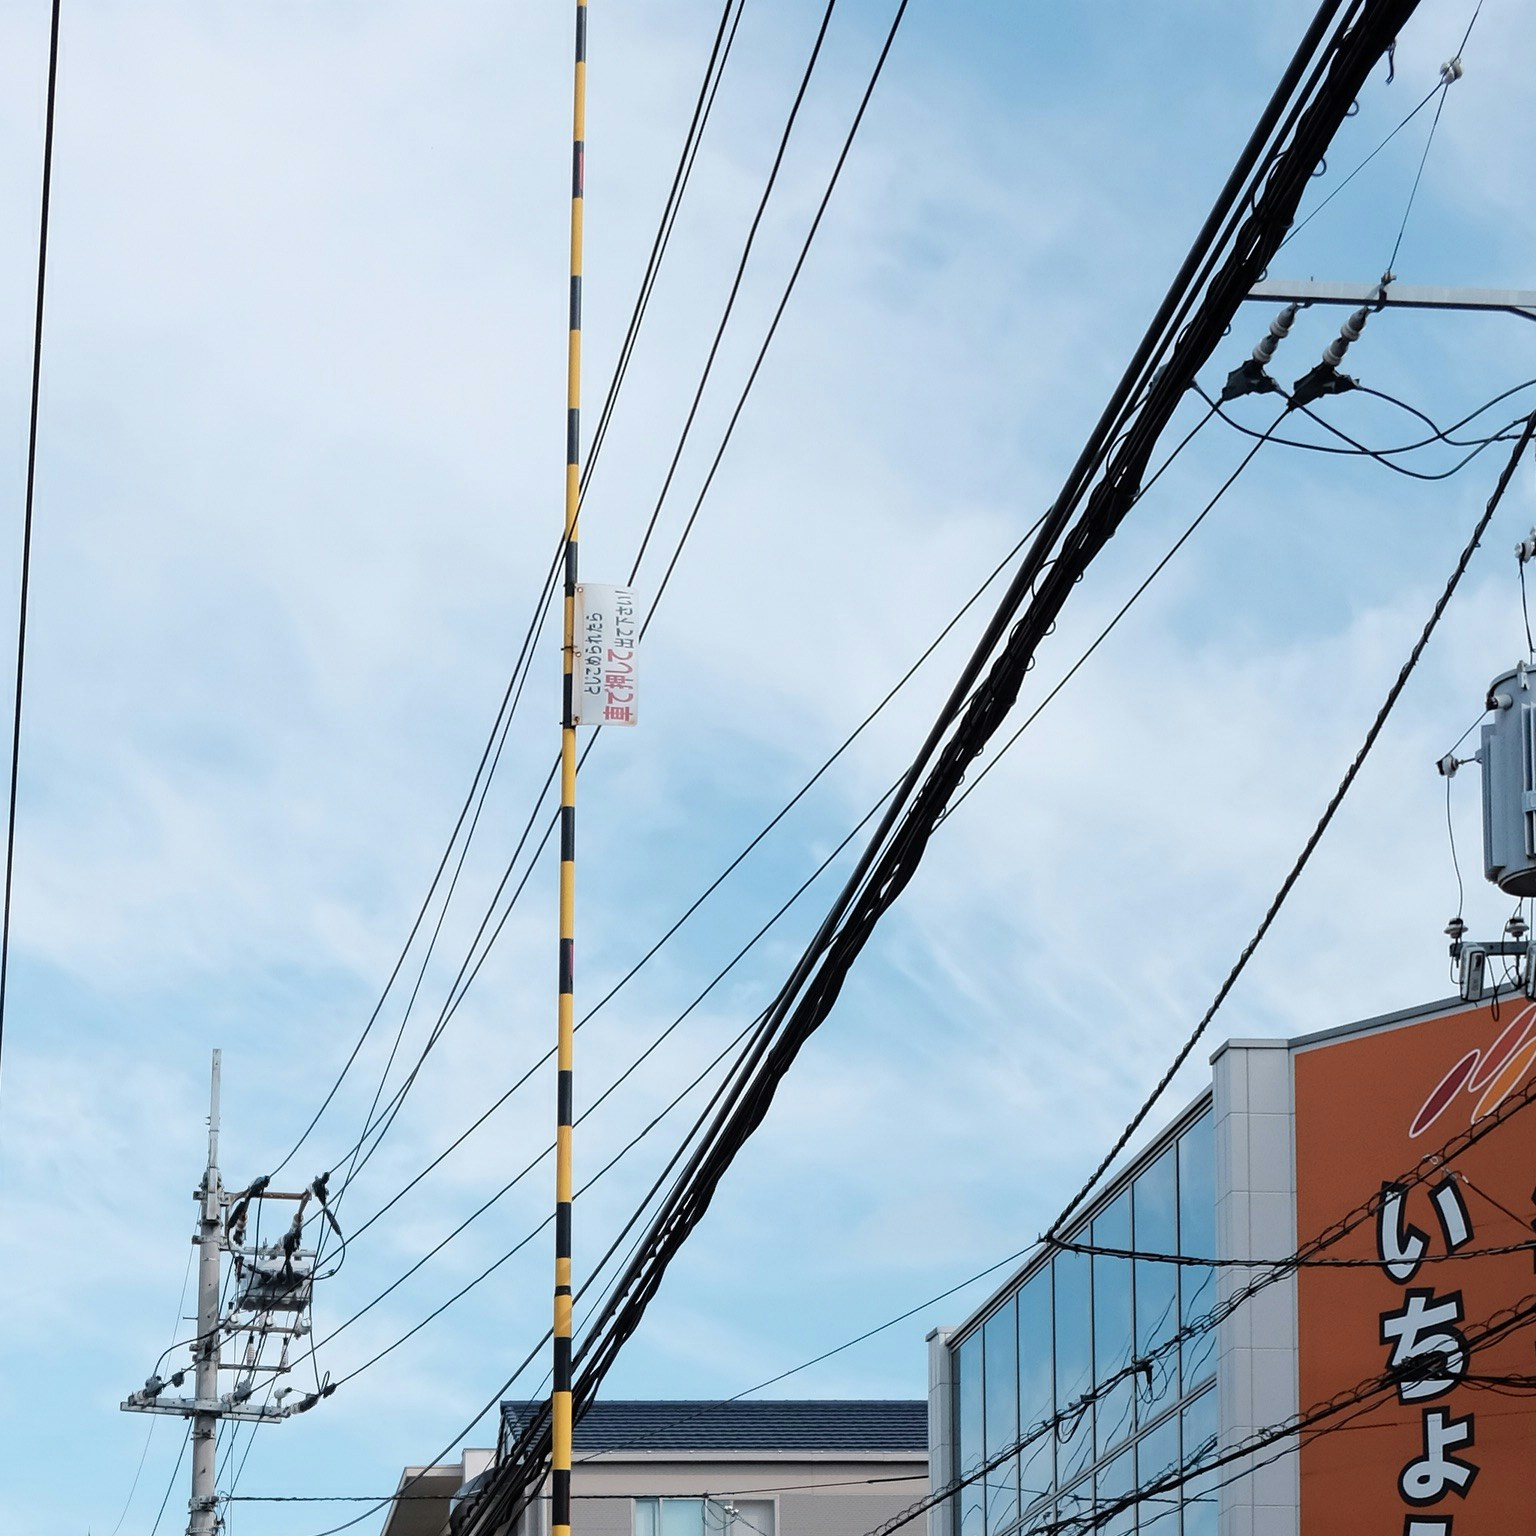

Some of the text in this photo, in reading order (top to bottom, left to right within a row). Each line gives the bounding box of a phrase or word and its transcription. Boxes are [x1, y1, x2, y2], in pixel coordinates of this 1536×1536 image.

[584, 612, 603, 696] とじこめられたら
